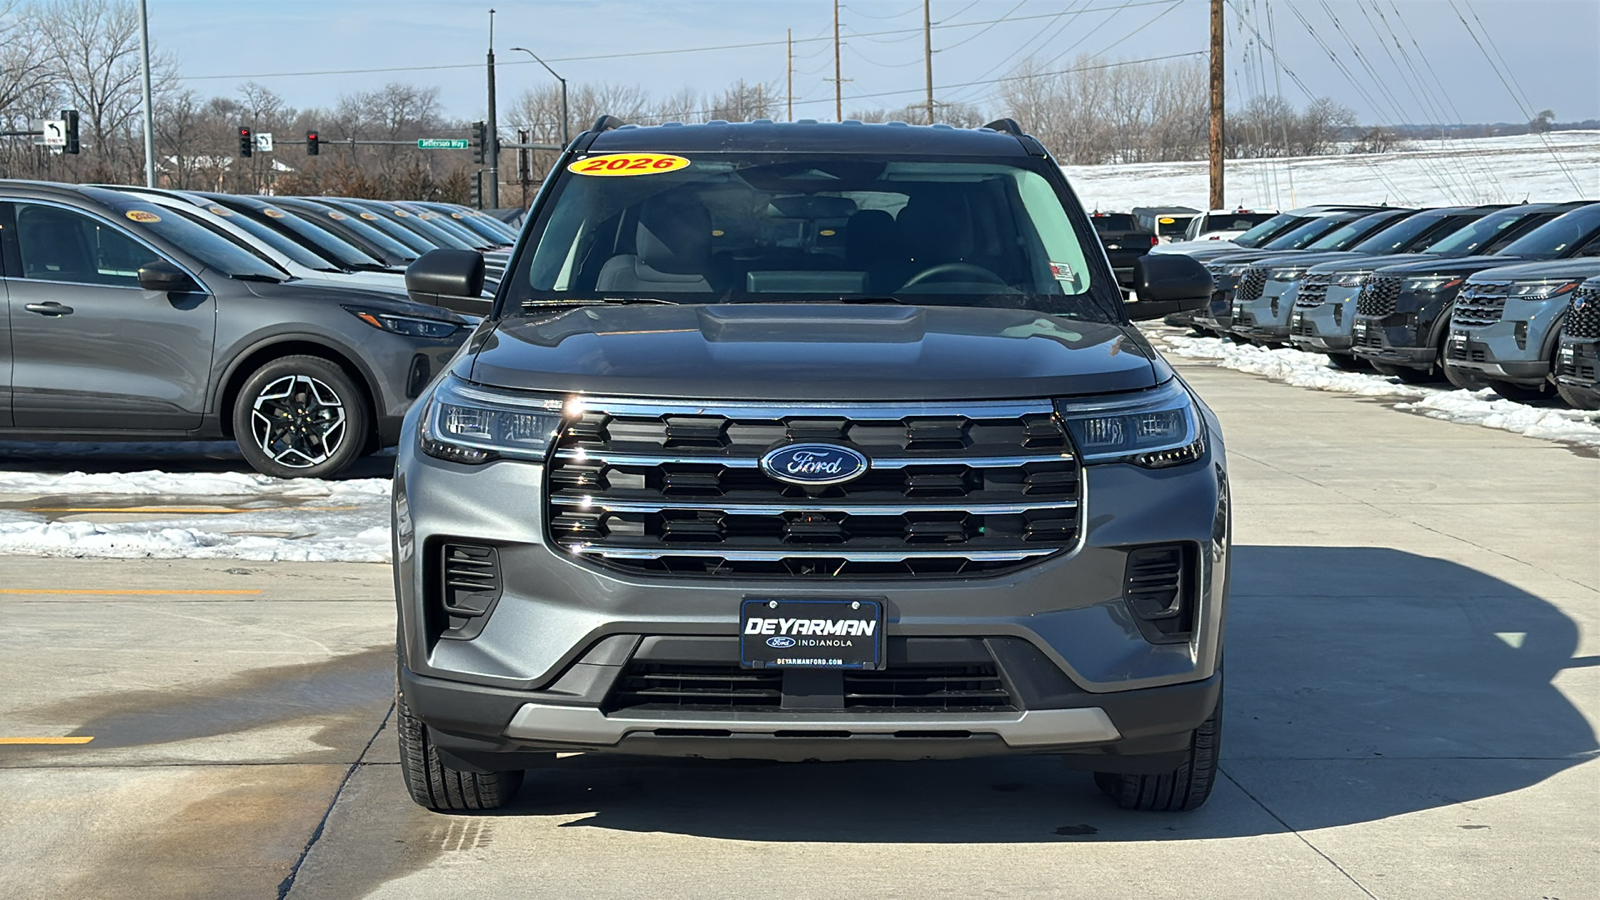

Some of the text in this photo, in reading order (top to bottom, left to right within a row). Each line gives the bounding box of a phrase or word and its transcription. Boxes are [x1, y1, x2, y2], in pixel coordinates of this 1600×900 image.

[451, 140, 465, 149] Way
[580, 158, 677, 172] 2026
[787, 451, 843, 474] Ford
[744, 617, 877, 636] DEYARMAN
[798, 639, 853, 647] INDIANOLA
